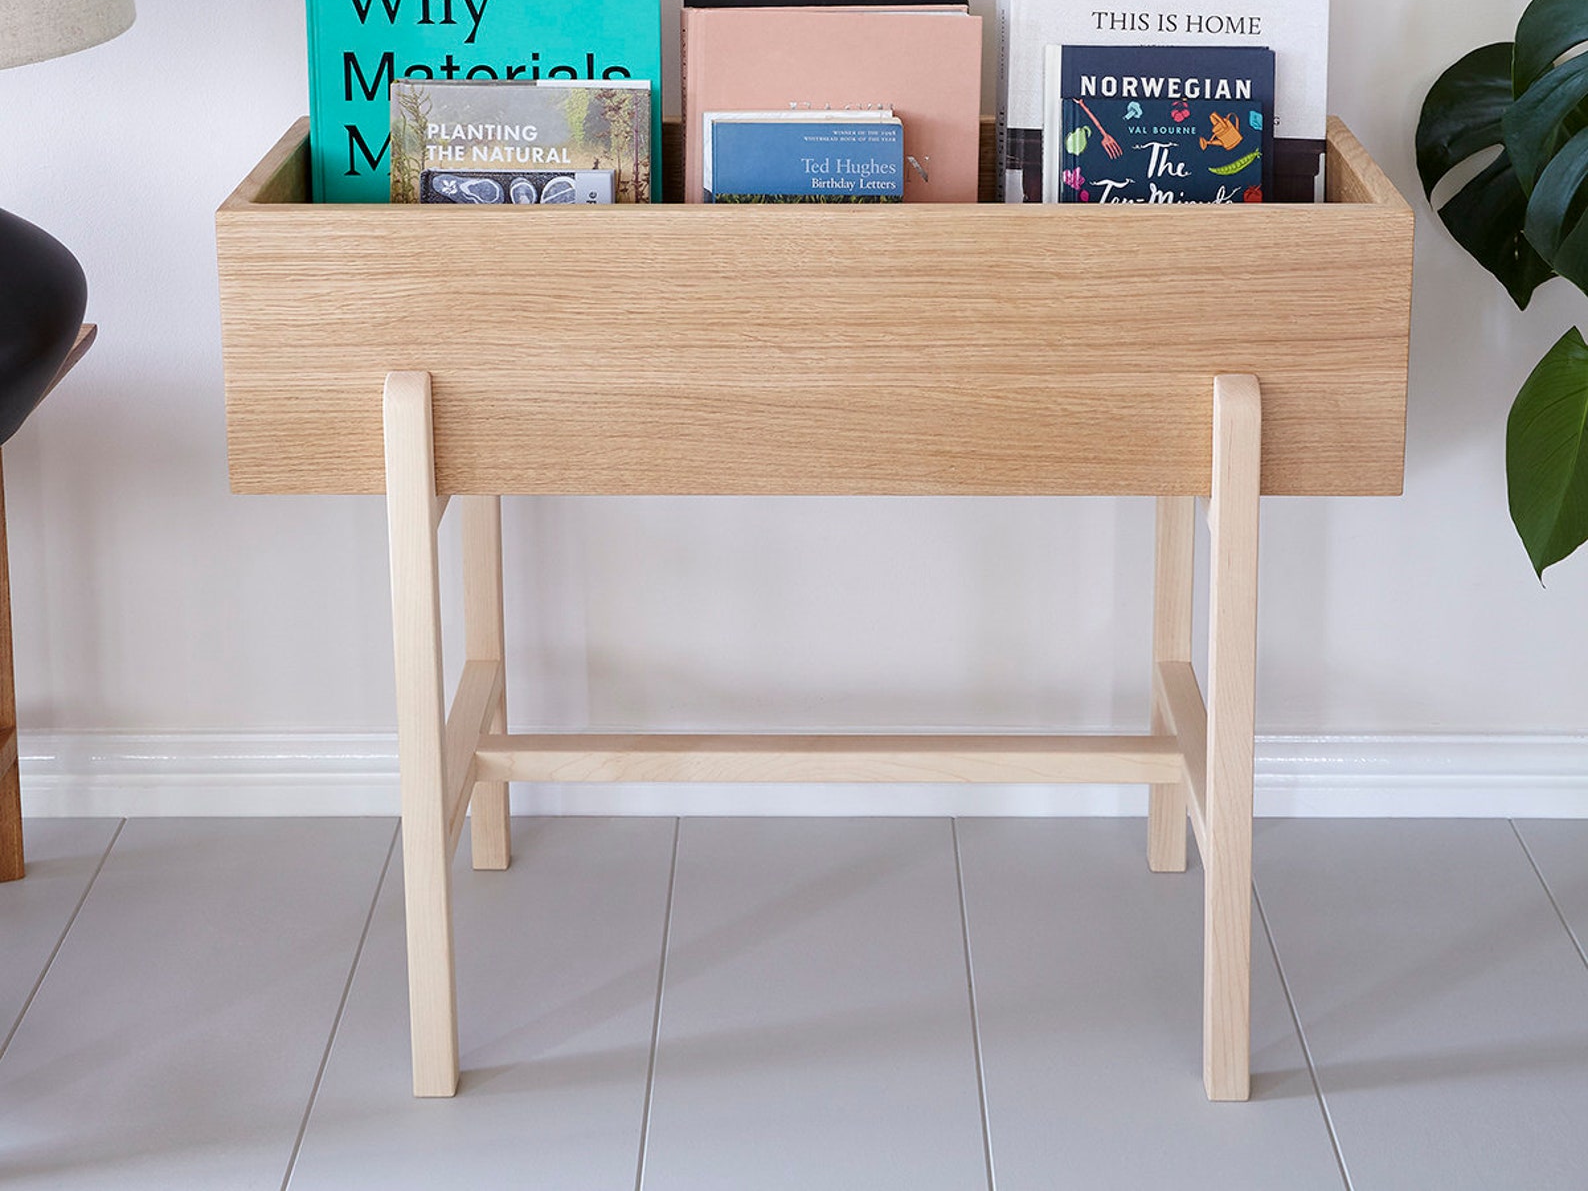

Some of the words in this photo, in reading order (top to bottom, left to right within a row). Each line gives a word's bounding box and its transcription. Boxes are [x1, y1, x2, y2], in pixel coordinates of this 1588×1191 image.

[1092, 11, 1150, 32] THIS
[1157, 13, 1178, 33] IS
[1186, 14, 1263, 36] HOME
[1080, 75, 1252, 100] NORWEGIAN
[426, 123, 538, 142] PLANTING
[1128, 126, 1148, 135] VAL
[1153, 126, 1197, 136] BOURNE
[426, 145, 464, 162] THE
[472, 146, 572, 165] NATURAL
[1132, 142, 1192, 179] The
[801, 158, 830, 174] Ted
[836, 158, 897, 178] Hughes
[811, 177, 856, 192] Birthday
[860, 178, 897, 190] Letters
